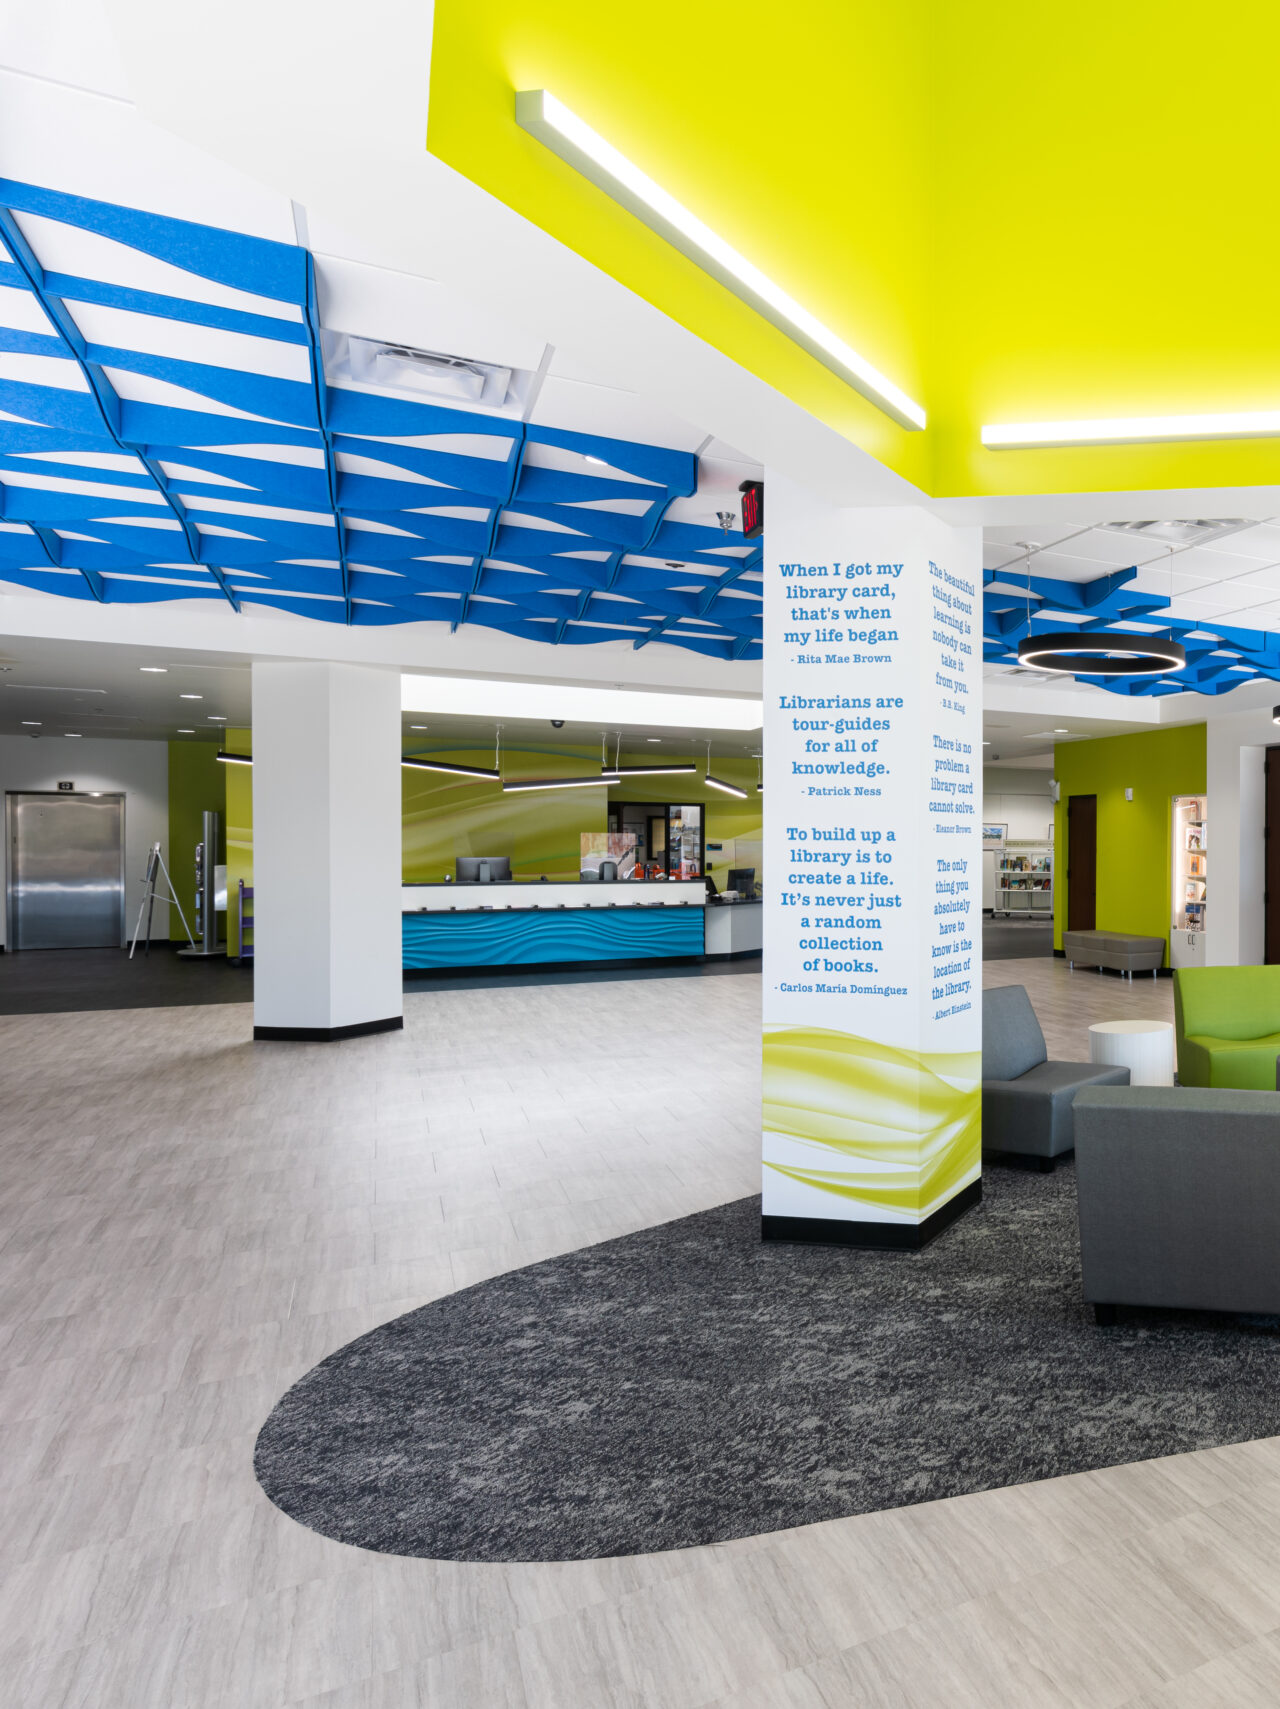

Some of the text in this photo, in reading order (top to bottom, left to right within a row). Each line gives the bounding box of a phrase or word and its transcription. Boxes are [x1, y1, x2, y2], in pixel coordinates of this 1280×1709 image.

[779, 563, 904, 579] When I got my
[929, 561, 975, 596] The beautiful
[787, 584, 895, 602] library card,
[933, 585, 972, 615] thing about
[792, 606, 892, 621] that's when
[934, 606, 970, 634] learning is
[784, 628, 898, 646] my life began
[933, 630, 971, 655] nobody can
[798, 655, 822, 664] Rita
[825, 654, 849, 664] Mae
[853, 654, 891, 663] Brown
[942, 653, 964, 672] take it
[936, 672, 968, 694] from you.
[779, 696, 903, 709] Librarians are
[954, 702, 965, 714] King
[792, 717, 890, 734] tour-guides
[806, 739, 879, 752] for all of
[933, 735, 972, 754] There is no
[792, 761, 890, 778] knowledge.
[935, 759, 969, 773] problem a
[808, 787, 850, 796] Patrick
[854, 787, 881, 796] Ness
[931, 778, 973, 795] library card
[929, 801, 975, 814] cannot solve.
[787, 827, 896, 844] To build up a
[956, 825, 972, 834] Brown
[790, 848, 892, 867] library is to
[937, 859, 967, 873] The only
[788, 872, 894, 885] create a life.
[936, 880, 969, 894] thing you
[781, 892, 902, 911] It’s never just
[934, 899, 970, 915] absolutely
[801, 915, 882, 928] a random
[939, 921, 965, 935] have to
[800, 936, 883, 951] collection
[932, 939, 972, 958] know is the
[803, 958, 878, 973] of books.
[934, 958, 970, 979] location of
[780, 982, 813, 992] Carlos
[816, 984, 847, 993] María
[849, 984, 908, 997] Domínguez
[932, 980, 971, 1000] the library.
[935, 1007, 951, 1020] Albert
[952, 1002, 971, 1015] Einstein
